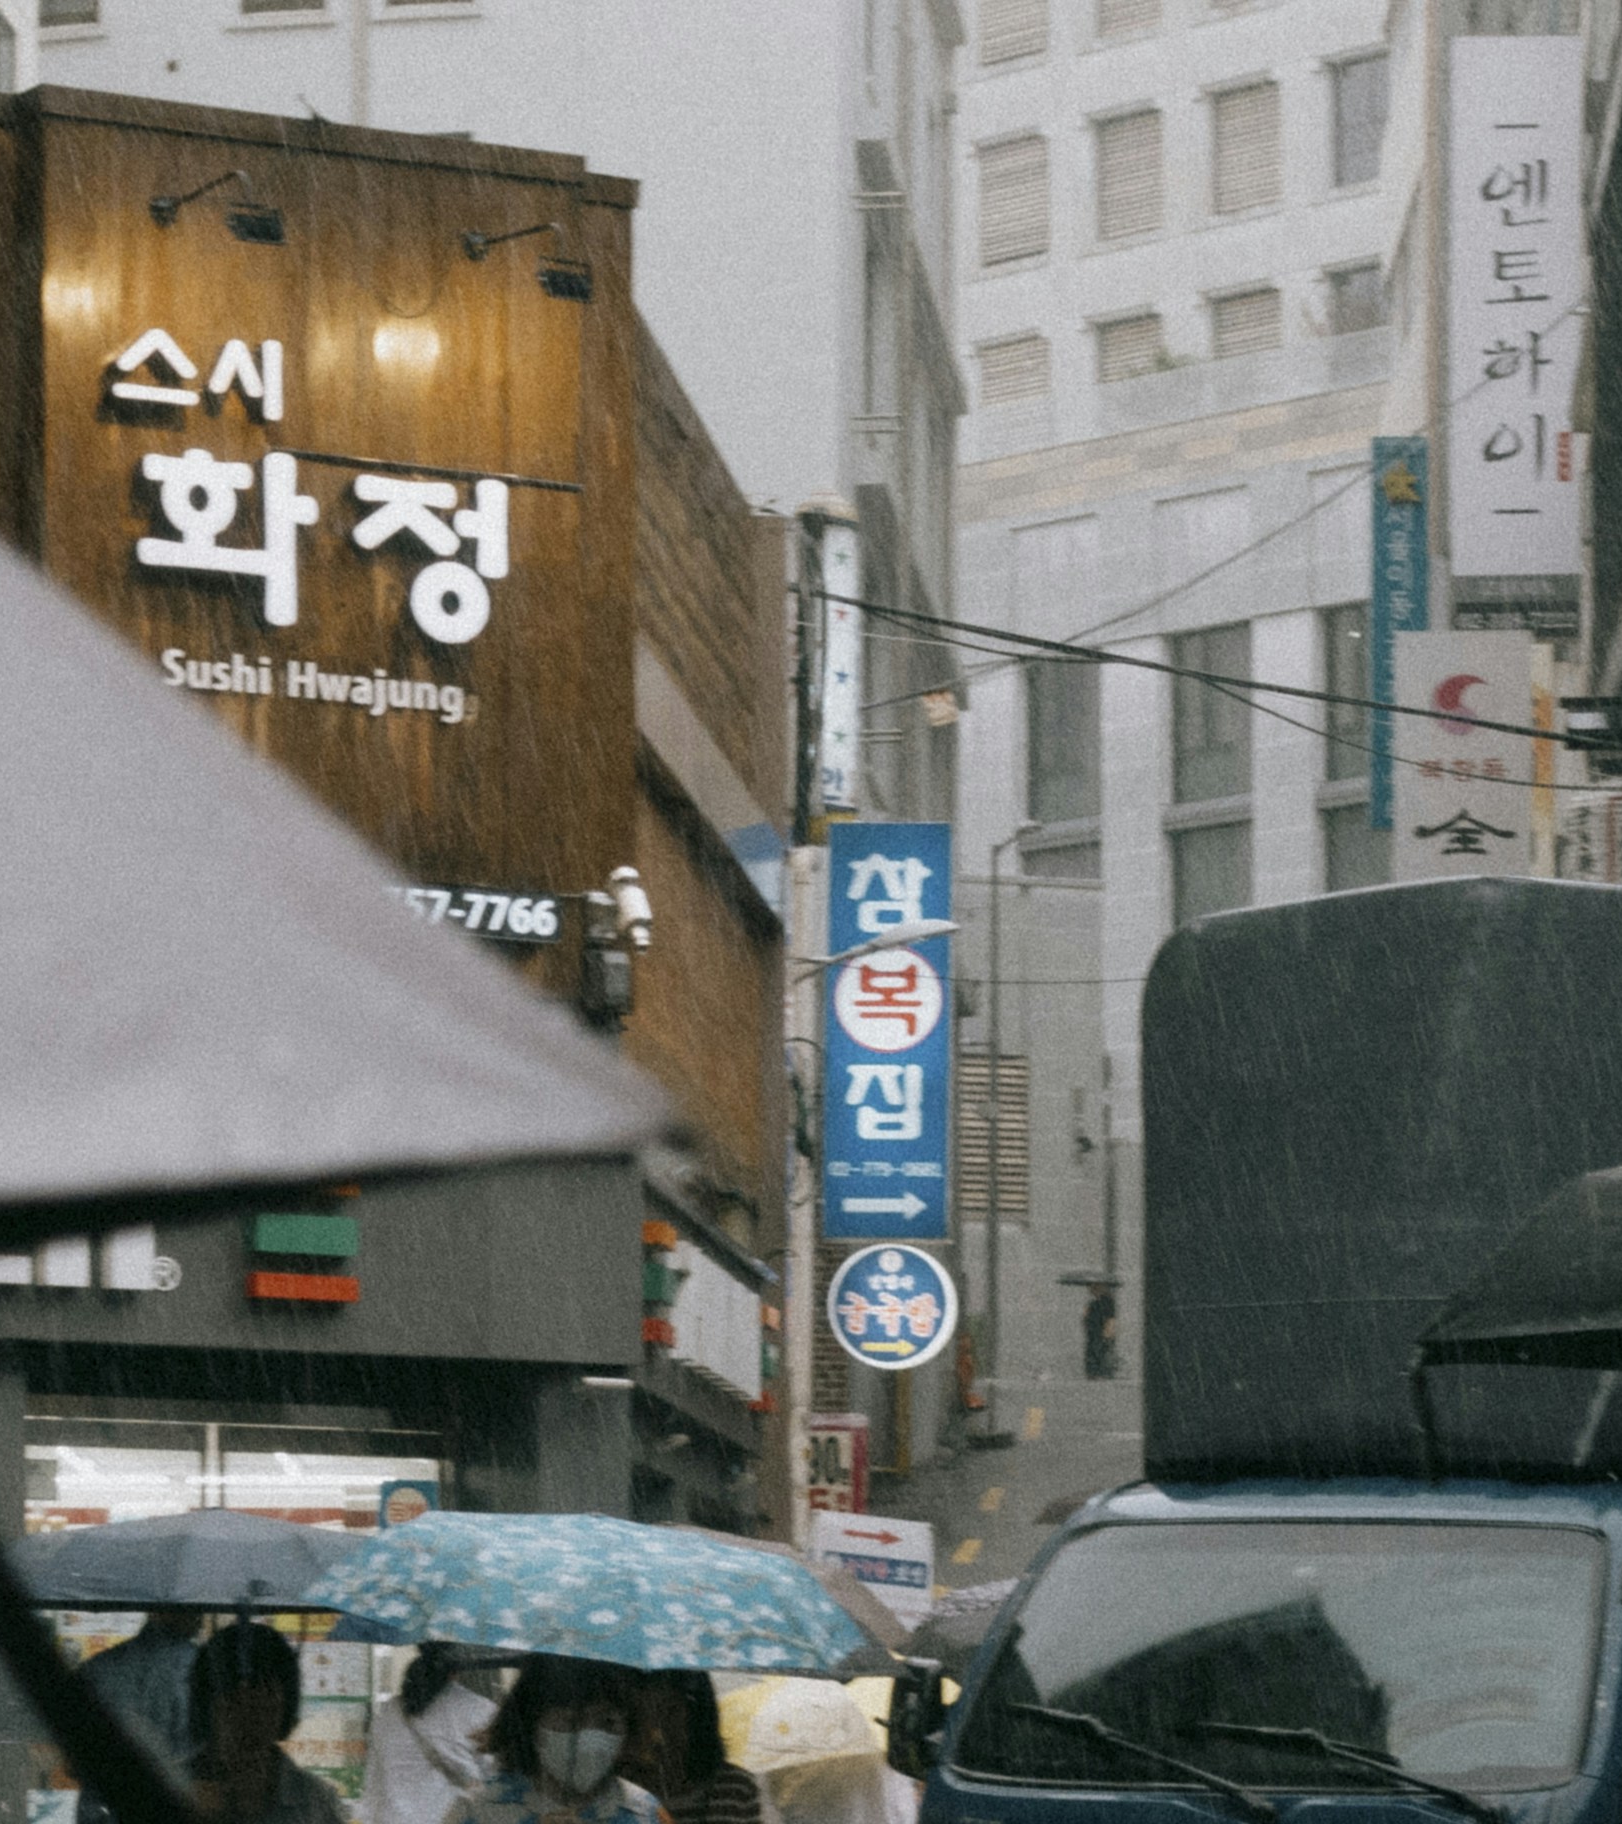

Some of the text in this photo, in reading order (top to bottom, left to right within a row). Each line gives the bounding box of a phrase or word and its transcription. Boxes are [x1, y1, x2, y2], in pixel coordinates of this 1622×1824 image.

[112, 327, 284, 422] 스시
[1480, 159, 1552, 482] 엔토하이
[134, 447, 510, 646] 화정
[160, 647, 467, 725] Sushi Hwajung
